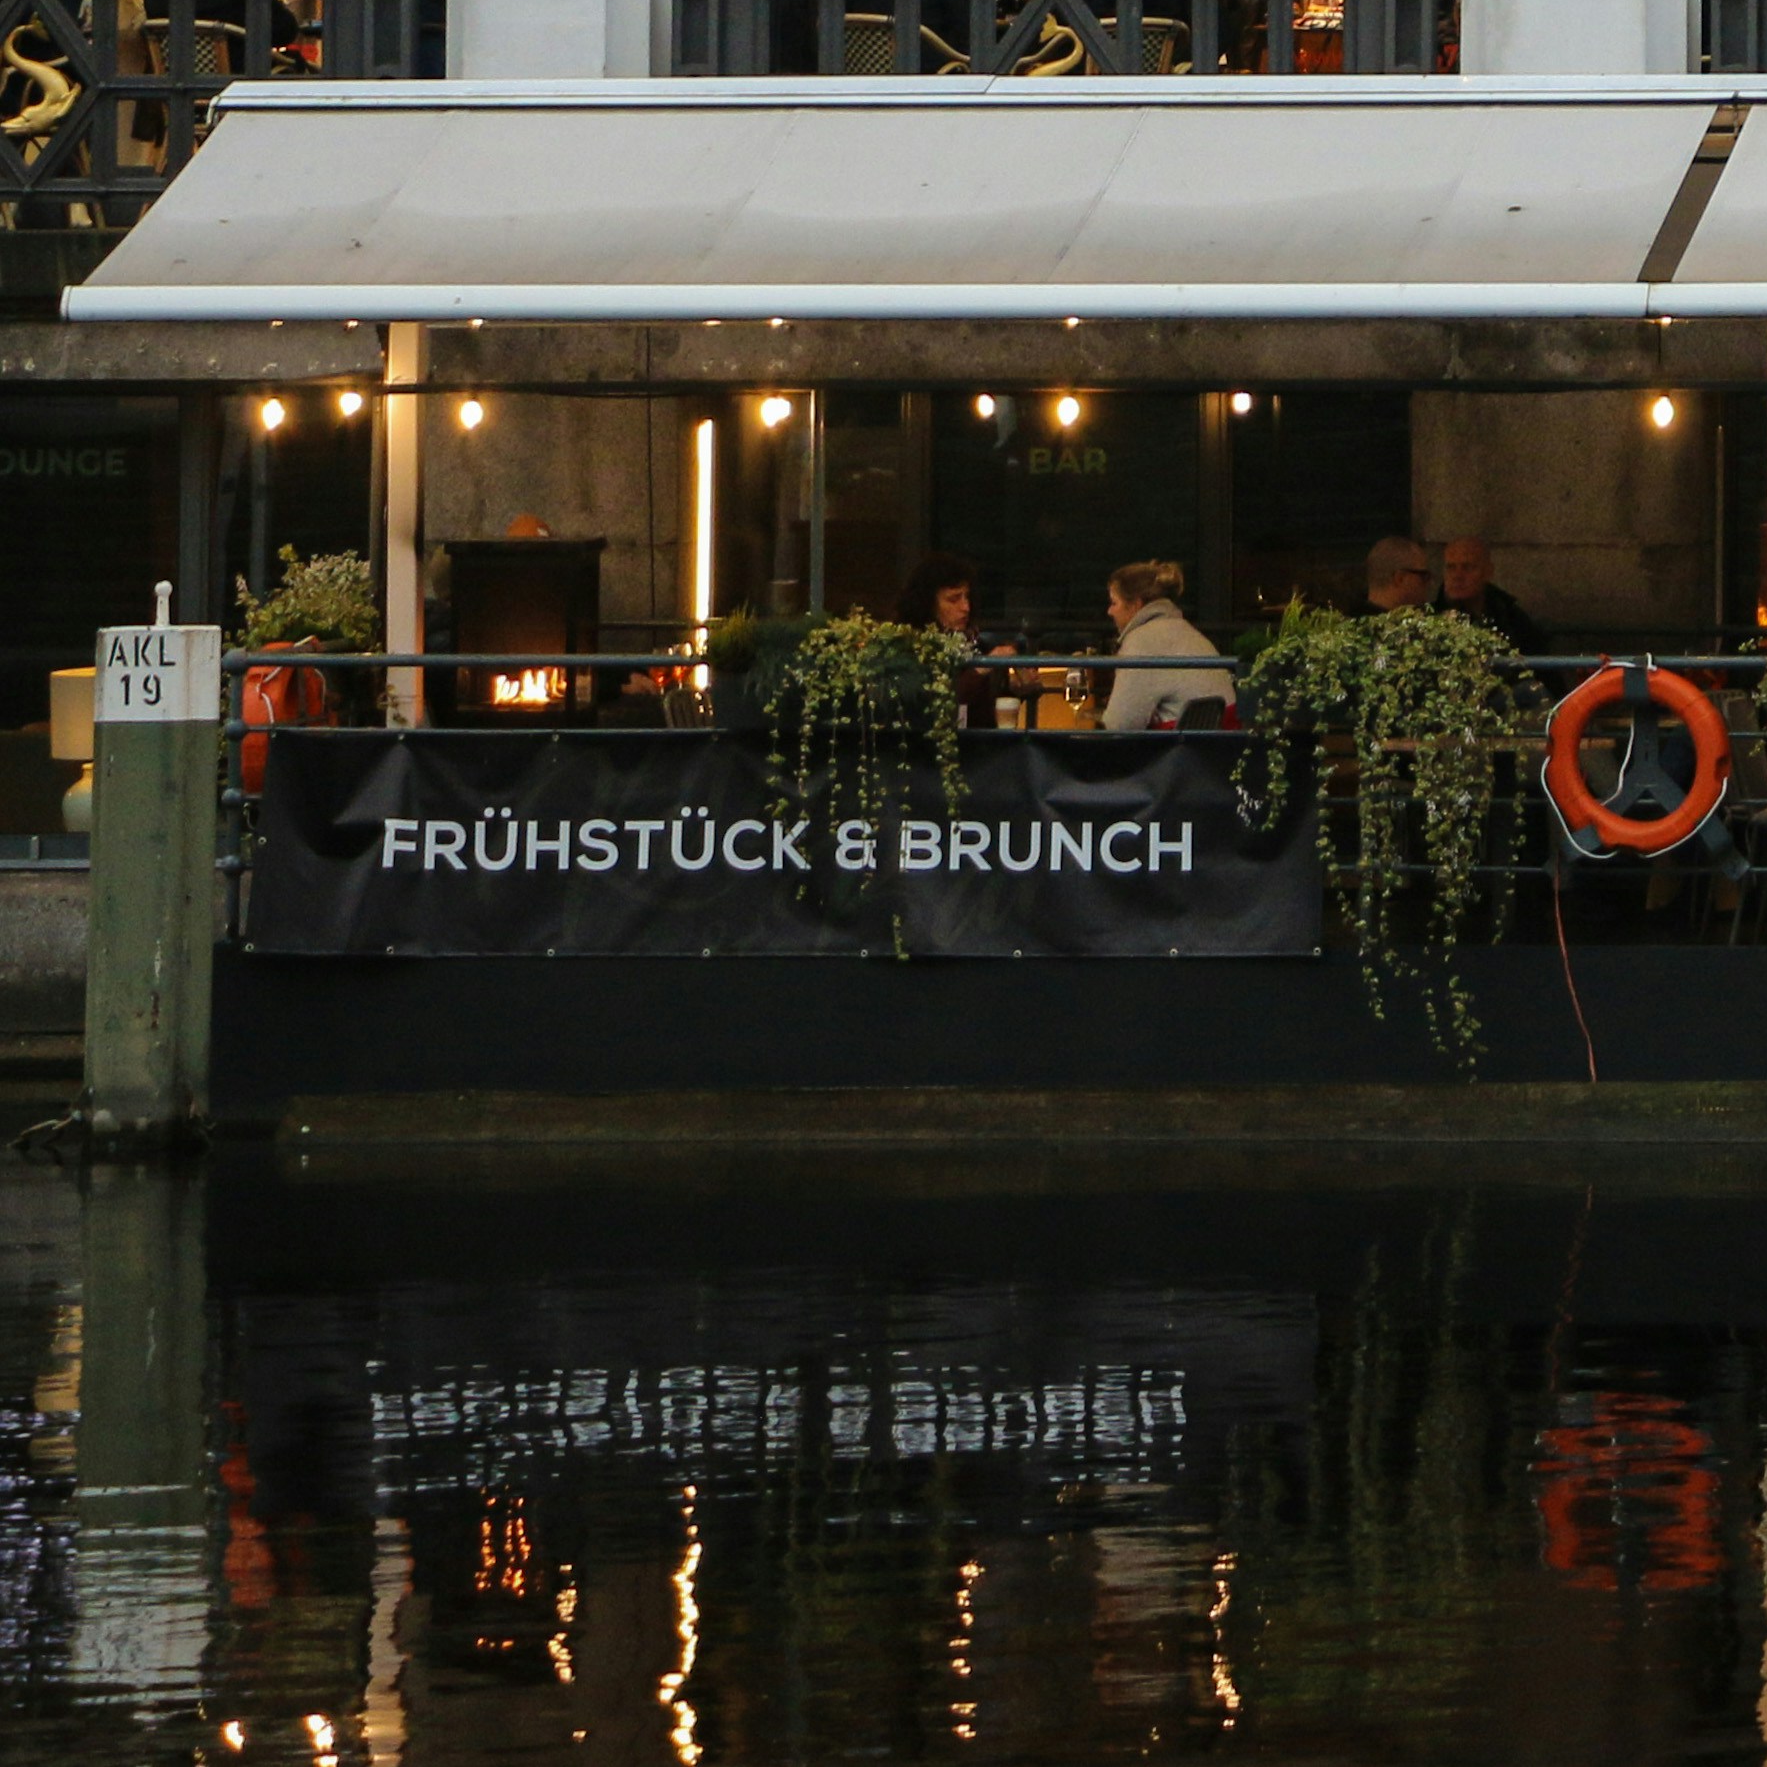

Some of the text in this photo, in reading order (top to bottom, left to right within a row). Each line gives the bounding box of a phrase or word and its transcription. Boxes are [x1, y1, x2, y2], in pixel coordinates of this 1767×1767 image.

[1028, 447, 1107, 475] BAR
[107, 634, 177, 668] AKL
[118, 673, 164, 707] 19
[382, 806, 1194, 873] FRÜHSTÜCK & BRUNCH
